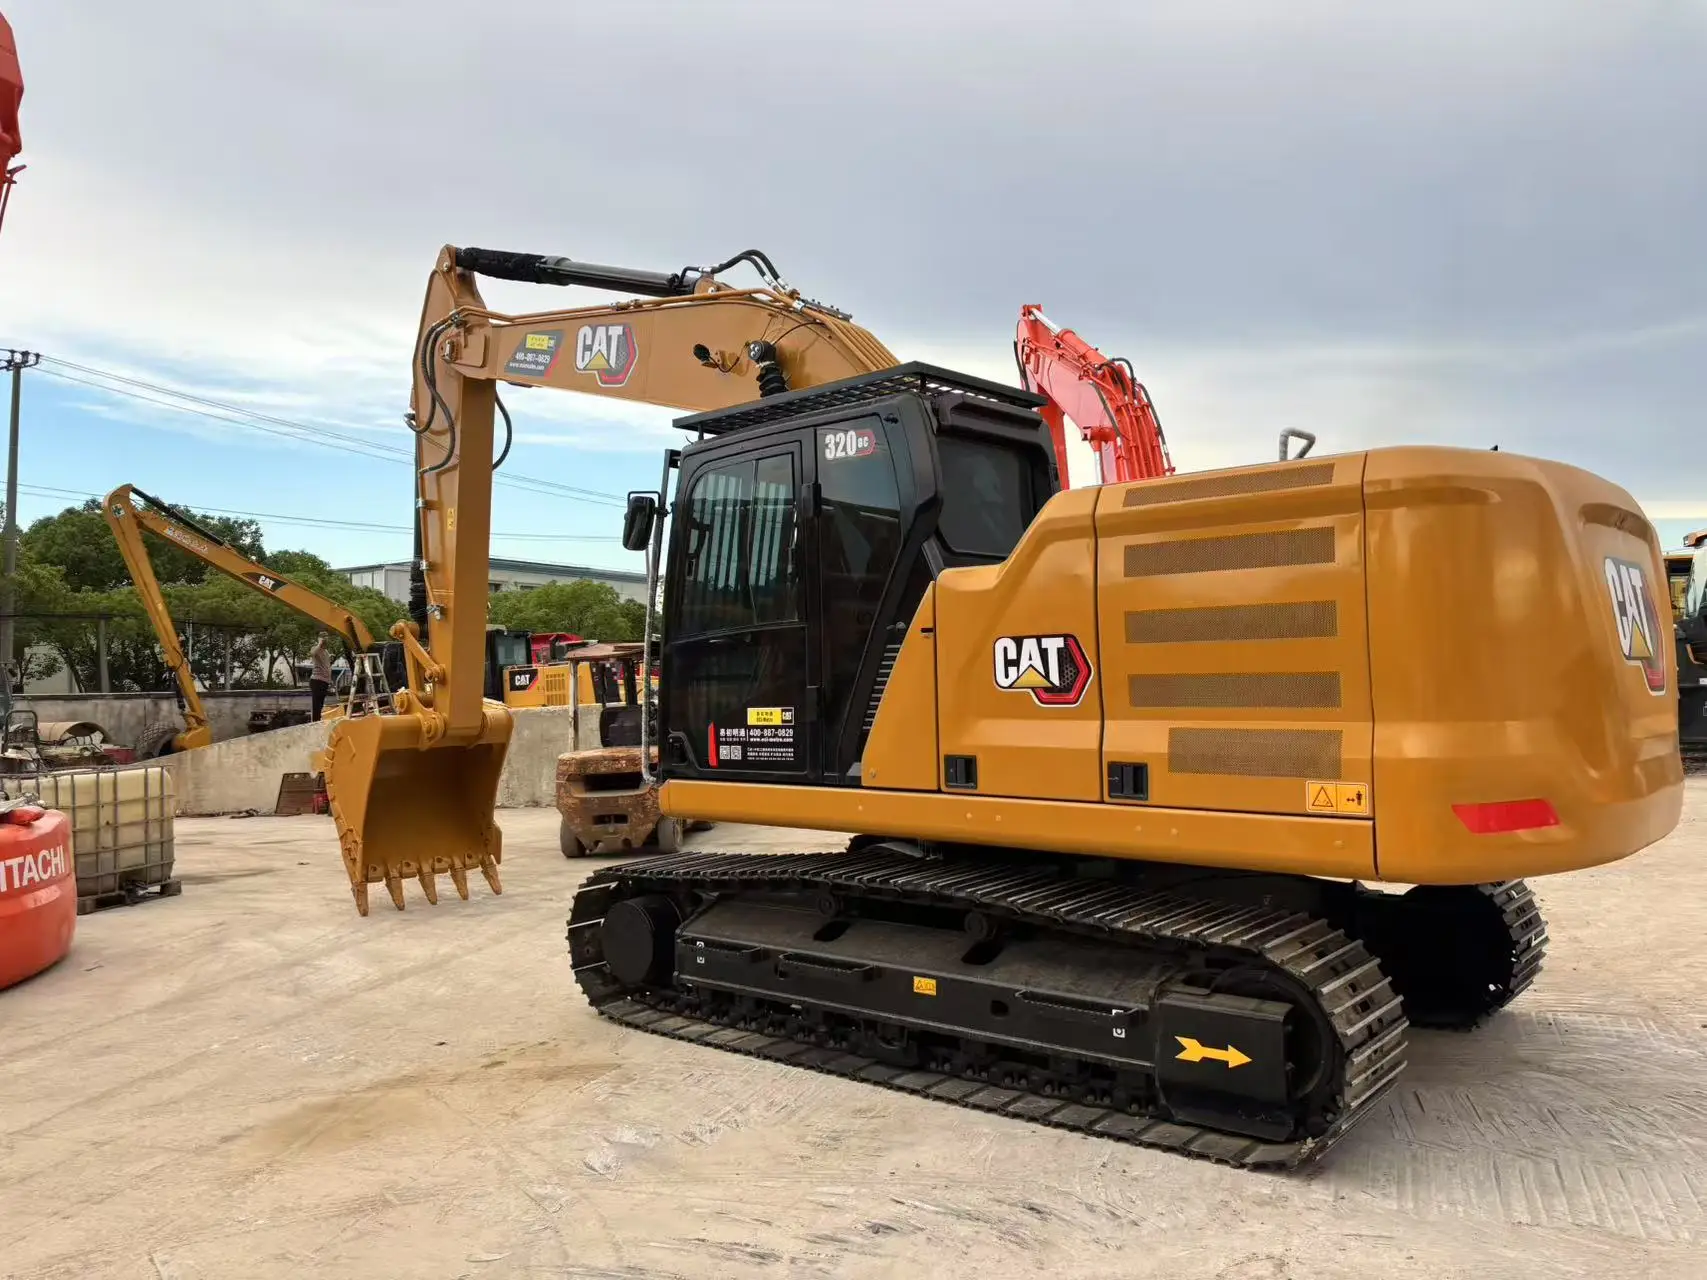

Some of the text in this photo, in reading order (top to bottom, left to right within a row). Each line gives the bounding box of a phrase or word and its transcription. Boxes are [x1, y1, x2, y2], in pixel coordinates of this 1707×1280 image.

[576, 325, 623, 370] CAT
[825, 430, 857, 460] 320
[258, 575, 275, 590] CAT
[1605, 558, 1654, 658] CAT
[995, 637, 1064, 687] CAT
[515, 674, 530, 686] CAT
[749, 728, 794, 737] 400-887-0829
